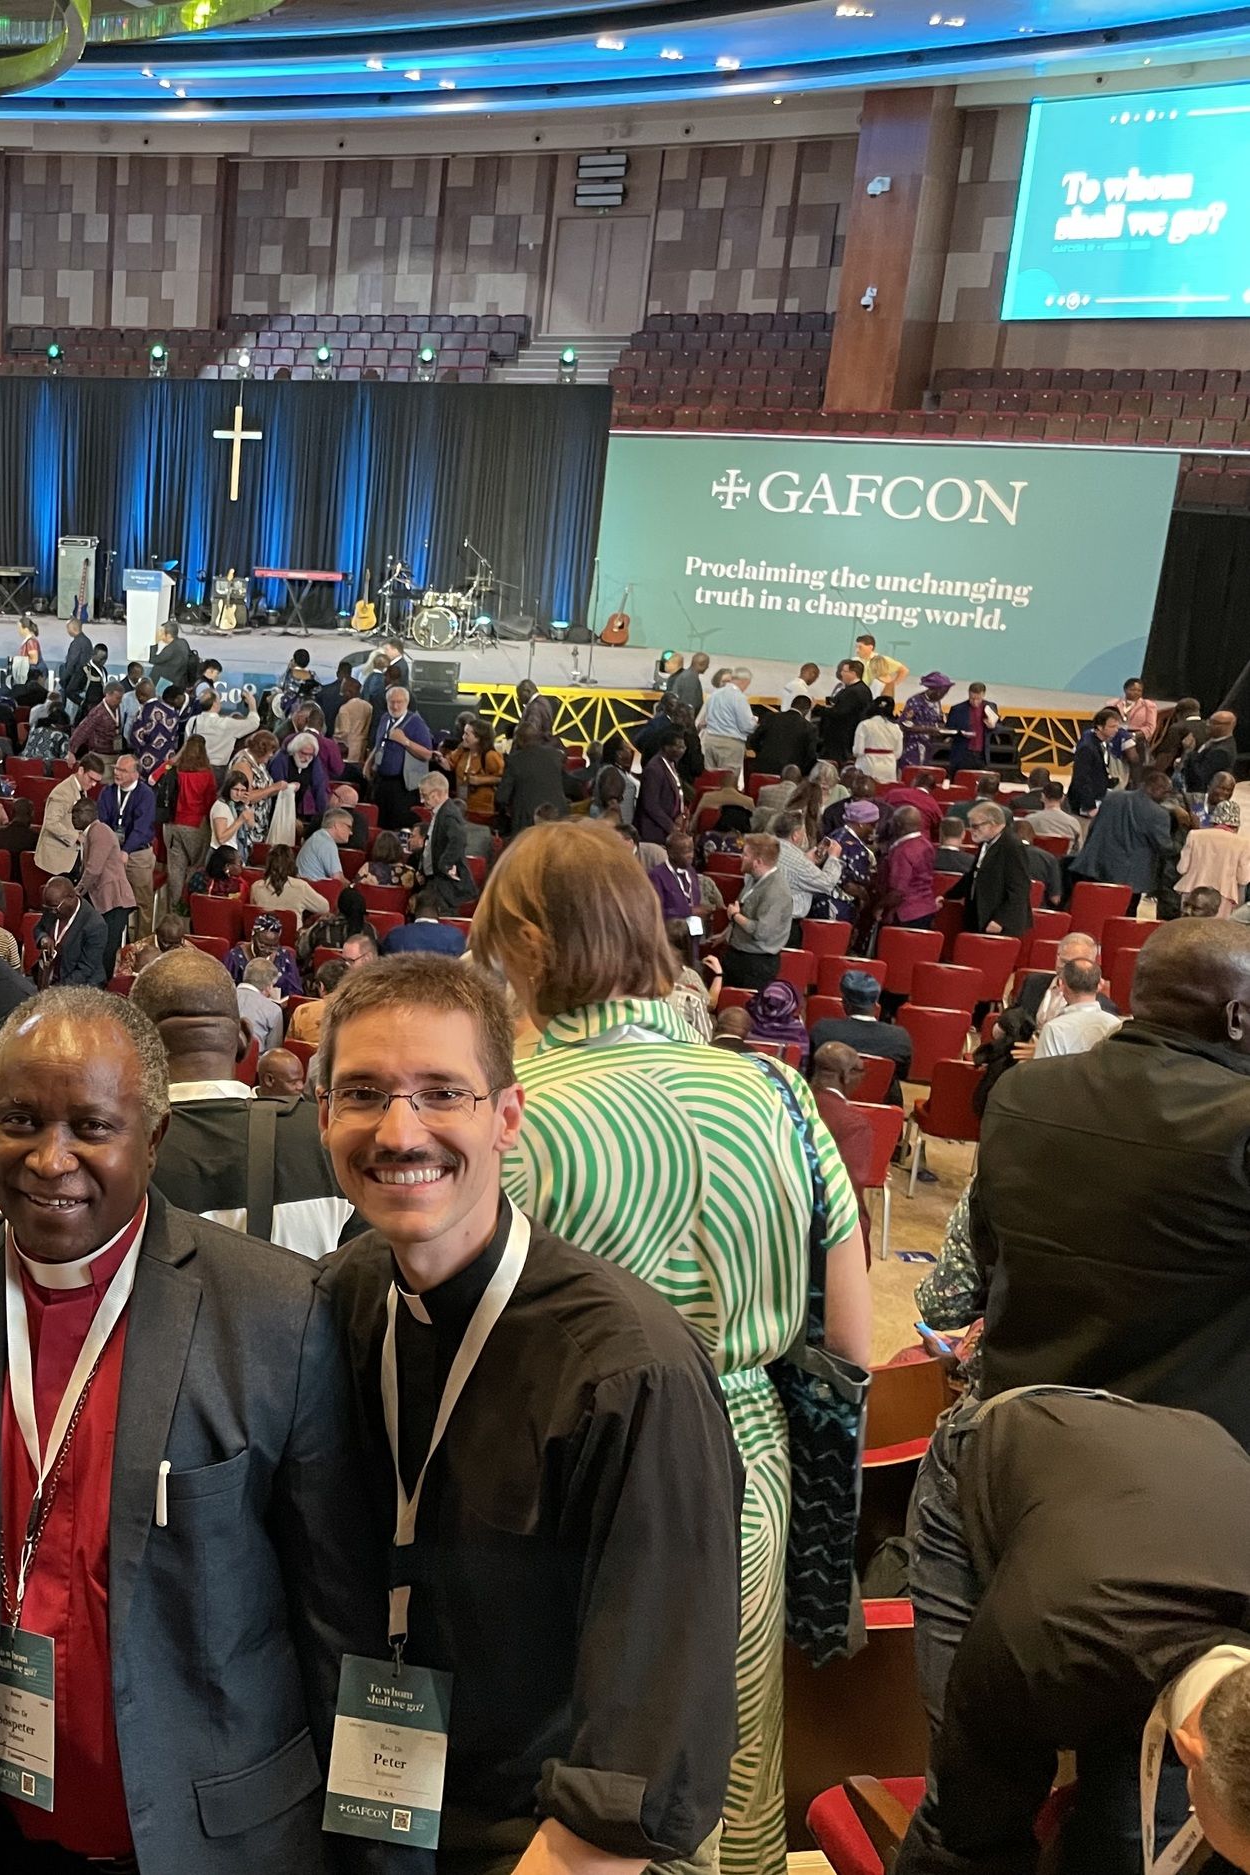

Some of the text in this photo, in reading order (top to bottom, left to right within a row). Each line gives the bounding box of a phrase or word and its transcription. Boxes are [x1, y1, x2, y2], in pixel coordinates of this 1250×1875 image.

[1061, 171, 1101, 205] To
[1128, 211, 1168, 238] we
[757, 469, 1030, 527] GAFCON
[685, 555, 1033, 608] Proclaiming the unchanging
[694, 584, 1007, 632] truth in a changing world.
[366, 1694, 391, 1707] shall
[392, 1700, 406, 1709] we
[369, 1683, 414, 1700] To whom
[373, 1752, 407, 1770] Peter
[346, 1804, 390, 1820] GAFCON
